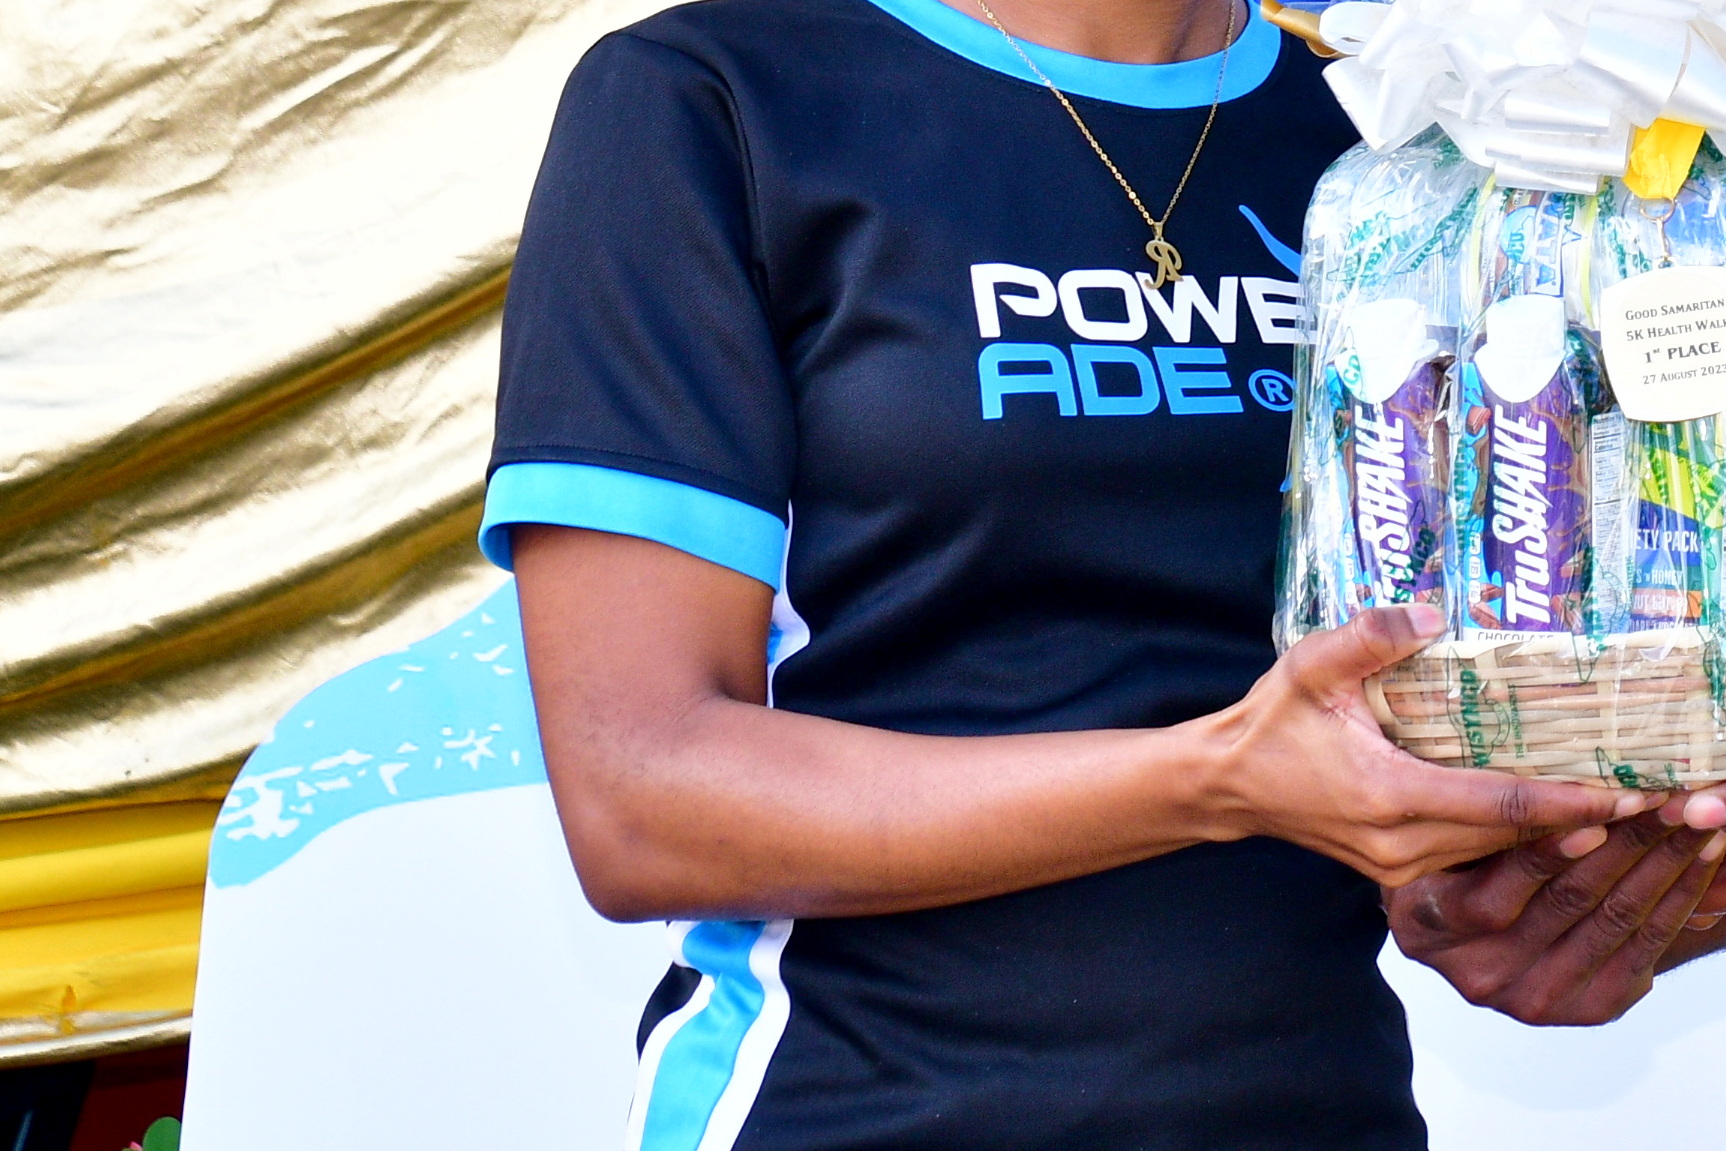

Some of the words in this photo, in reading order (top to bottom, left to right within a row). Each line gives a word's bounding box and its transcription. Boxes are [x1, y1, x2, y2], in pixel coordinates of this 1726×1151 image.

[1625, 308, 1658, 321] GOOD
[1661, 298, 1725, 316] SAMARITAN
[1626, 328, 1644, 341] 5K
[1648, 324, 1692, 338] HEALTH
[1668, 341, 1722, 360] PLACE
[978, 343, 1244, 419] ADE
[1643, 374, 1656, 385] 27
[1660, 369, 1698, 382] AUGUST
[1492, 404, 1555, 624] TruSHAKE
[1664, 530, 1699, 553] PACK
